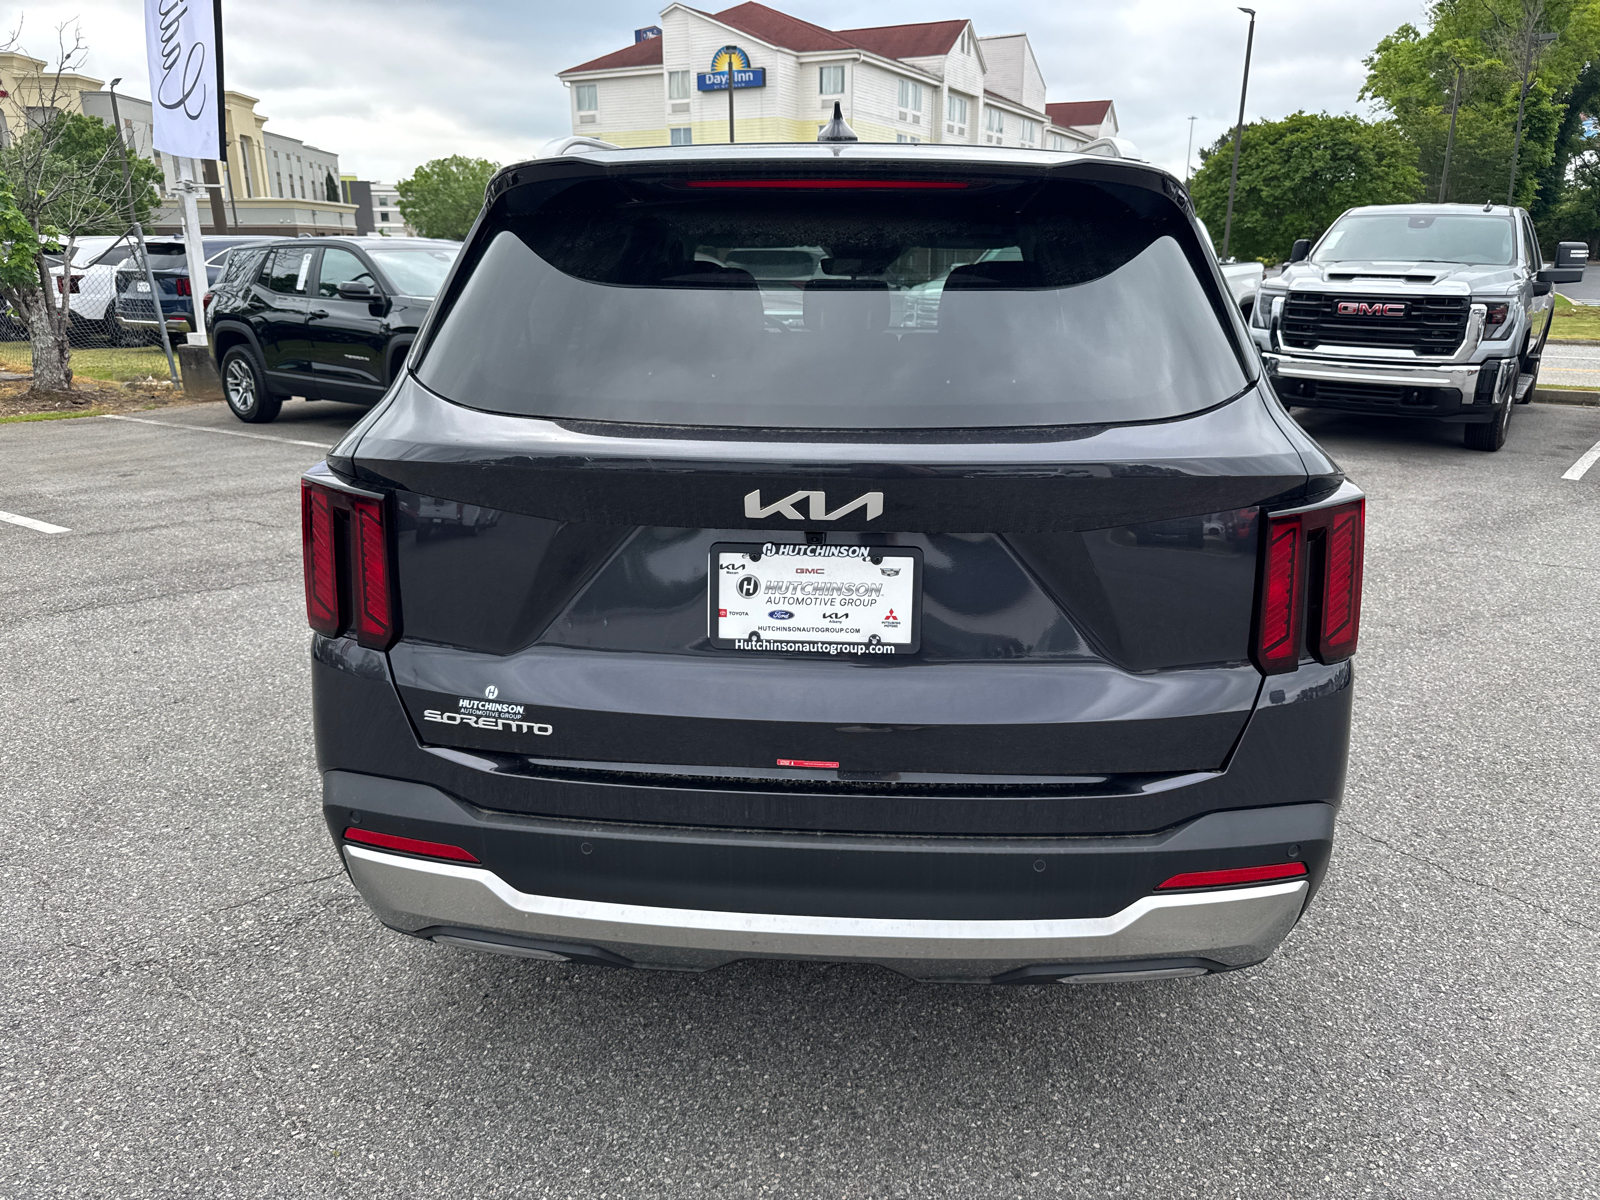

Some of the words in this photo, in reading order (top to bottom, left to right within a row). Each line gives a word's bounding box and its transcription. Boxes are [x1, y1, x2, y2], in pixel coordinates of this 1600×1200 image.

[734, 72, 754, 82] Inn
[1337, 302, 1405, 317] GMC
[744, 489, 884, 522] KIA
[779, 544, 870, 558] HUTCHINSON
[719, 563, 745, 571] KIA
[763, 580, 882, 597] HUTCHINSON
[765, 596, 836, 606] AUTOMOTIVE
[839, 597, 878, 607] GROUP
[771, 610, 791, 619] Ford
[822, 612, 849, 620] KIA
[757, 626, 861, 634] HUTCHINSONAUTOGROUP.COM
[735, 639, 895, 655] Hutchinsonautogroup.com
[458, 698, 524, 714] HUTCHINSON
[460, 708, 499, 718] AUTOMOTIVE
[423, 709, 553, 736] SORENTO
